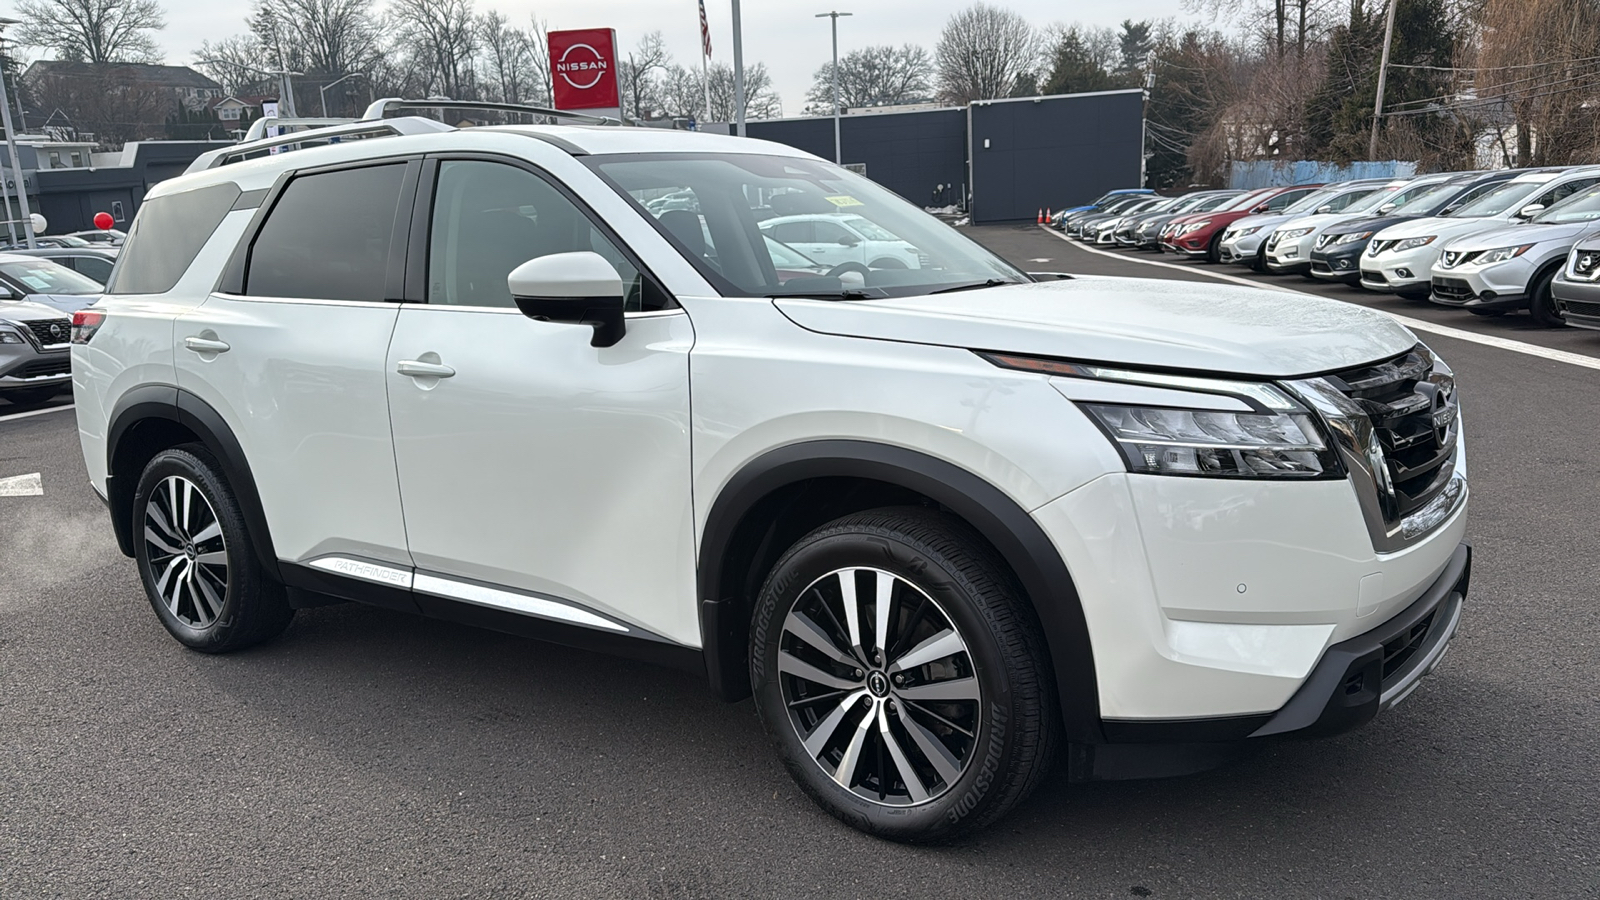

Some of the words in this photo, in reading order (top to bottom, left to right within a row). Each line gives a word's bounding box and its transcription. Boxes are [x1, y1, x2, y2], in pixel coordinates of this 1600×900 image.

[557, 60, 607, 72] NISSAN
[333, 560, 408, 583] PATHFINDER
[946, 701, 1009, 824] BRIDGESTONE
